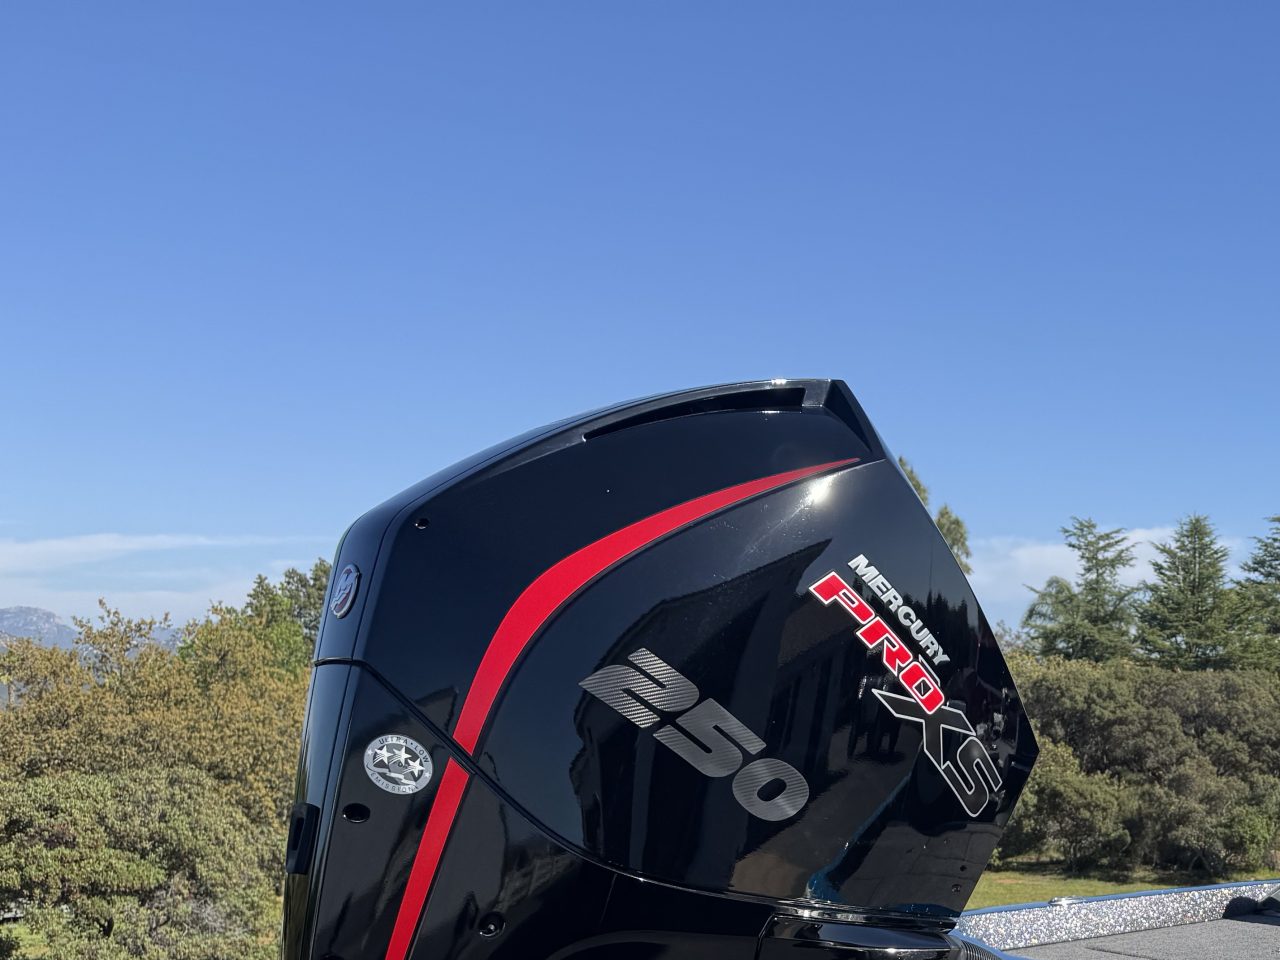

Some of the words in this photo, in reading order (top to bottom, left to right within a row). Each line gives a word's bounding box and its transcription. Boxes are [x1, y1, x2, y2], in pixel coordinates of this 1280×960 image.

[809, 571, 945, 715] PRO
[848, 553, 950, 666] MERCURY
[414, 745, 430, 763] LOW
[578, 647, 810, 822] 250
[871, 655, 1003, 818] XS
